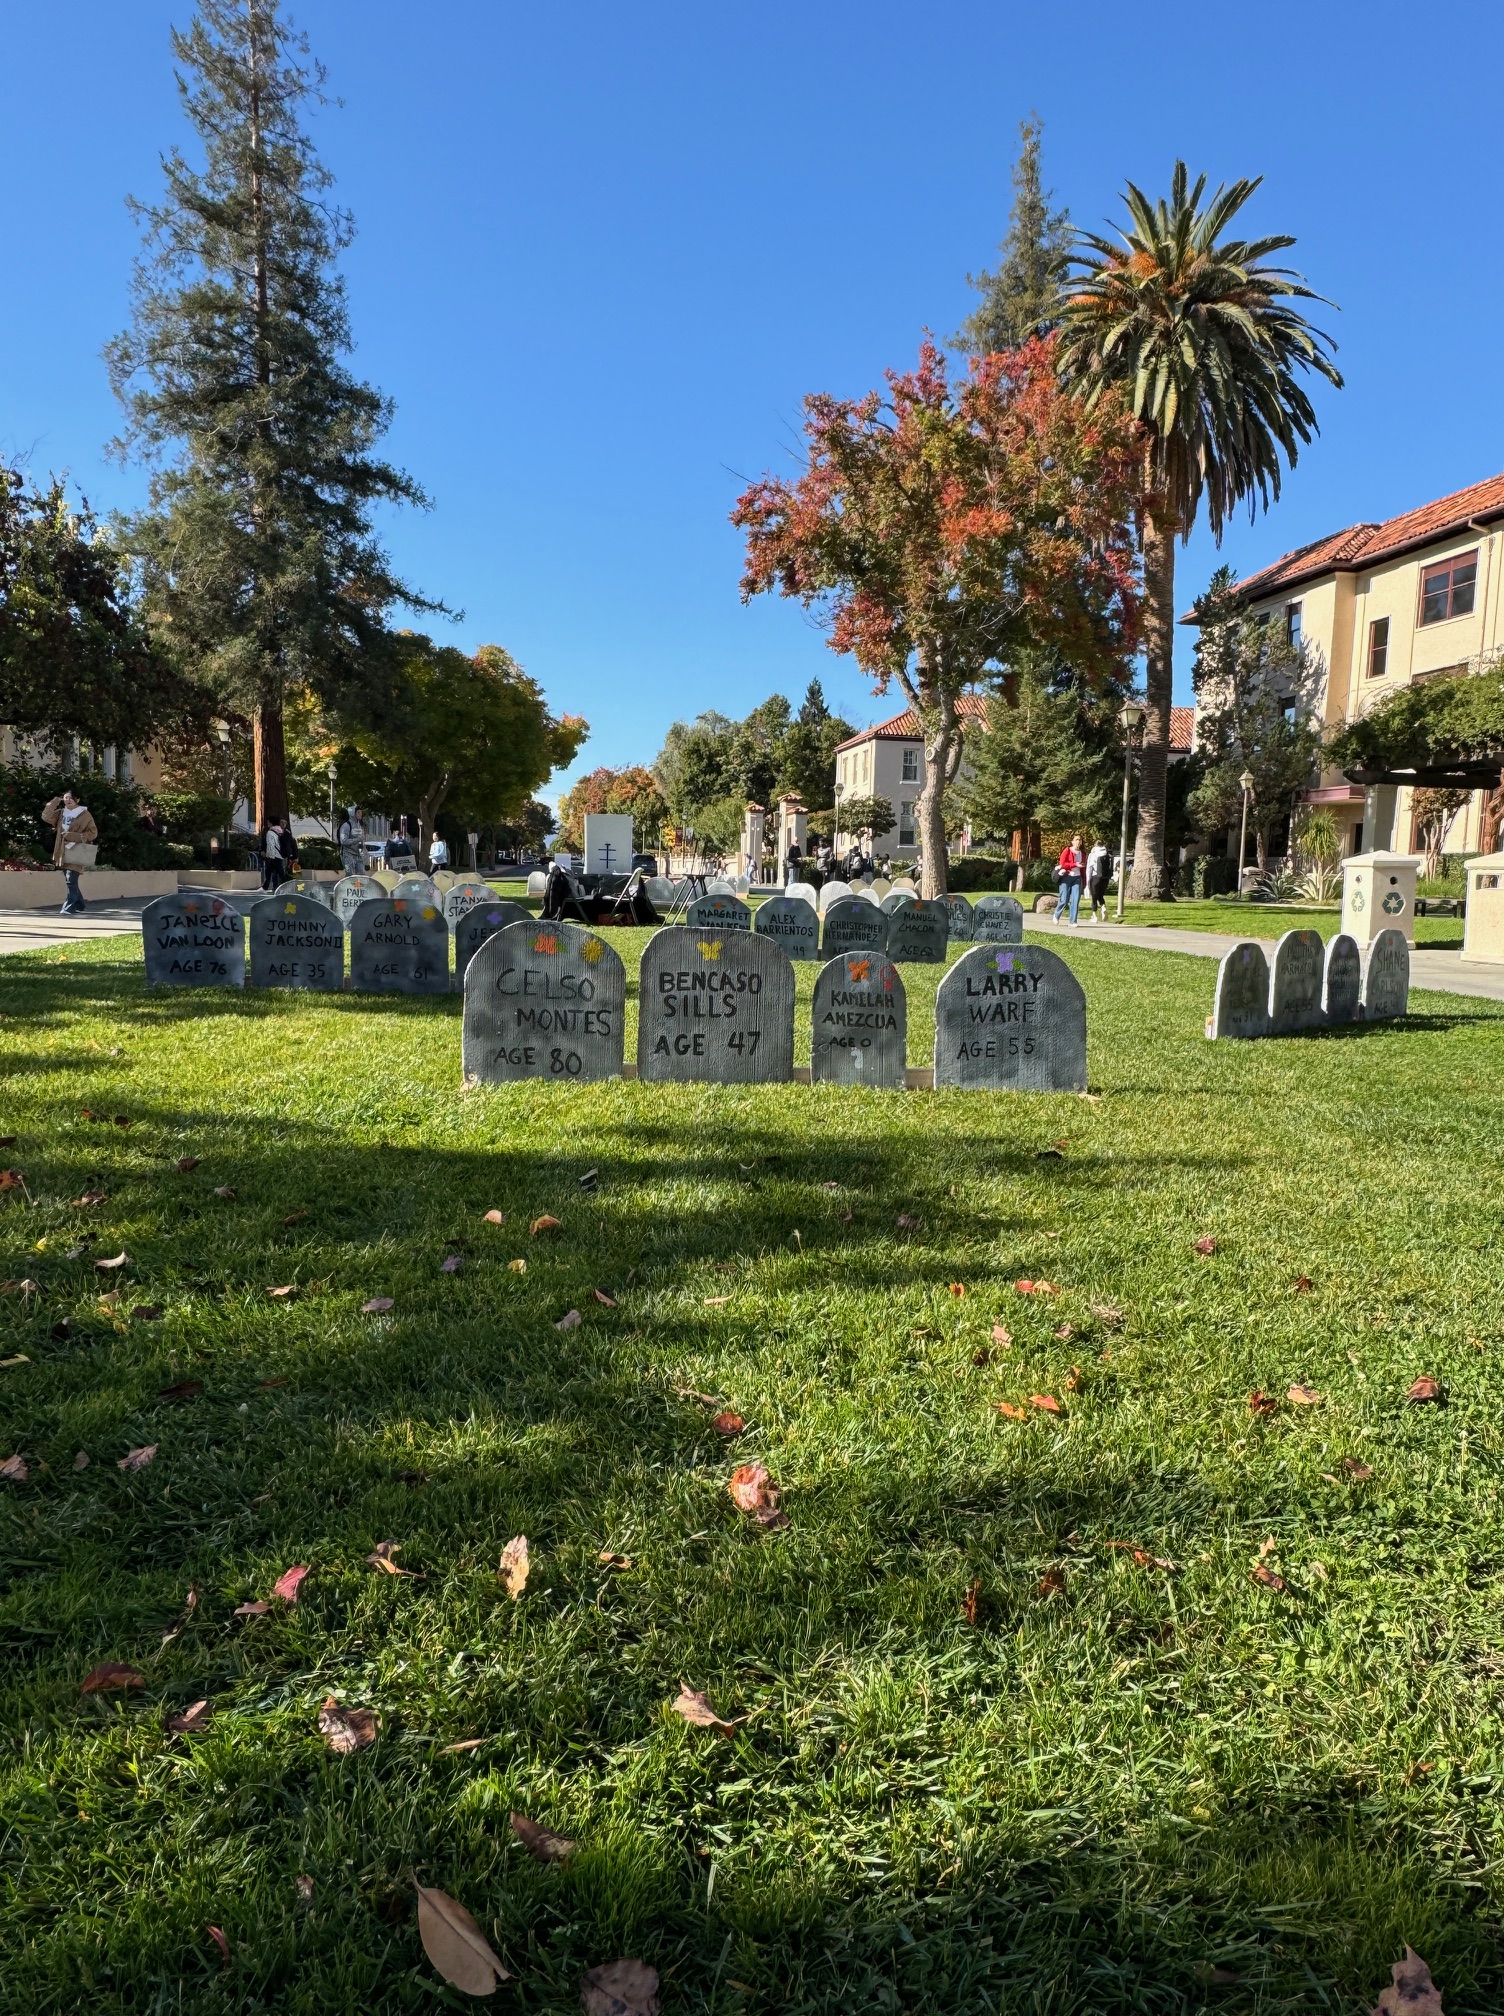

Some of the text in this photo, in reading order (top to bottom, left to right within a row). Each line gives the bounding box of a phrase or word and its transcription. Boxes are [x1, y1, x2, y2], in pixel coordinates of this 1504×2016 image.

[452, 896, 486, 906] TANY
[373, 913, 413, 929] GARY
[697, 908, 750, 921] MARGARET
[770, 913, 796, 925] ALEX
[903, 911, 938, 921] MANUEL
[267, 919, 327, 934] JOHNNY
[755, 923, 814, 937] BARRIENTOS
[829, 920, 883, 935] CHRISTOPHER
[899, 923, 935, 933] CHACON
[157, 934, 235, 949] VAN LOON
[364, 931, 420, 946] ARNOLD
[824, 930, 878, 943] HERNANDEZ
[792, 945, 805, 956] 49
[900, 945, 918, 955] AGE
[169, 959, 227, 975] AGE 76
[1376, 947, 1405, 974] SHANE
[268, 963, 326, 978] AGE 35
[373, 963, 428, 980] AGE 61
[496, 967, 595, 1001] CELSO
[659, 970, 762, 994] BENCASO
[966, 972, 1044, 997] LARRY
[664, 994, 737, 1018] SILLS
[830, 989, 895, 1009] KAMILAH
[969, 1001, 1036, 1024] WARF
[516, 1008, 611, 1037] MONTES
[822, 1011, 898, 1031] AMEZCUA
[654, 1031, 761, 1056] AGE 47
[829, 1036, 872, 1048] AGE 0
[957, 1037, 1036, 1060] AGE 55
[493, 1046, 582, 1075] AGE 80
